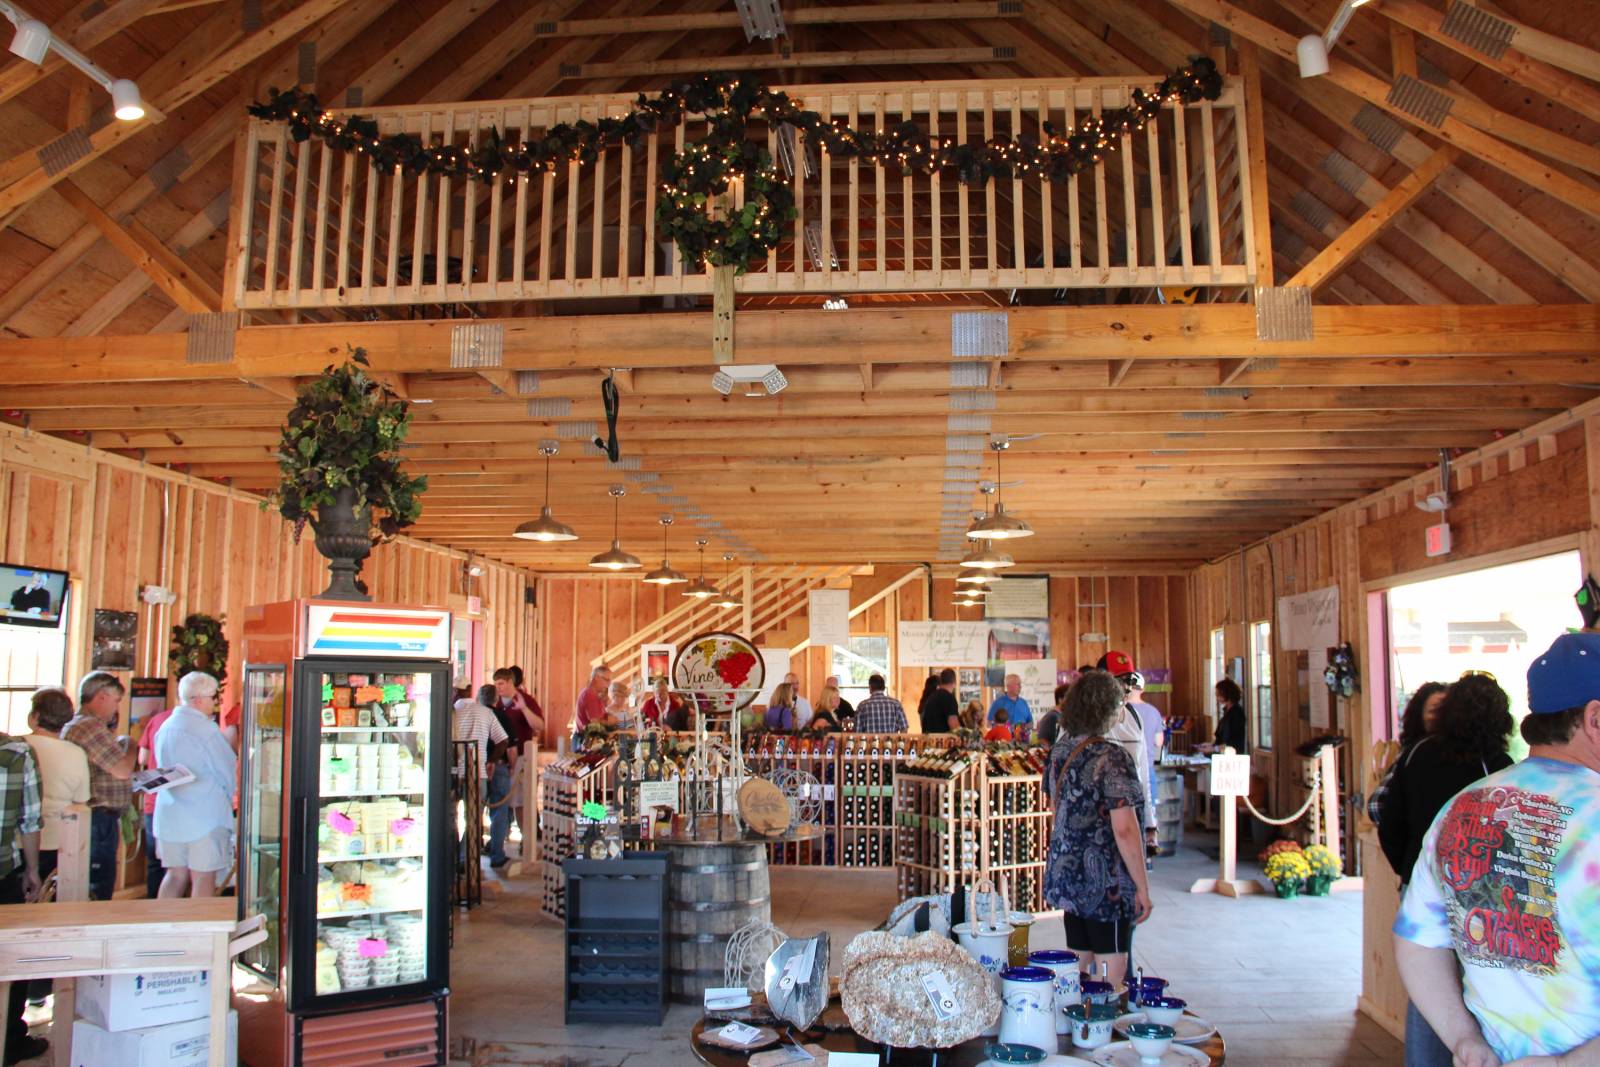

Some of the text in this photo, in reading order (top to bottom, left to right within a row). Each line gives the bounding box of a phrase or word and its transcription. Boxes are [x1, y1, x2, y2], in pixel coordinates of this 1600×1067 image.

[681, 659, 715, 684] Vino
[1218, 760, 1243, 774] EXIT
[1216, 777, 1244, 790] ONLY
[1502, 887, 1556, 941] Steve
[146, 976, 198, 990] PERISHABLE
